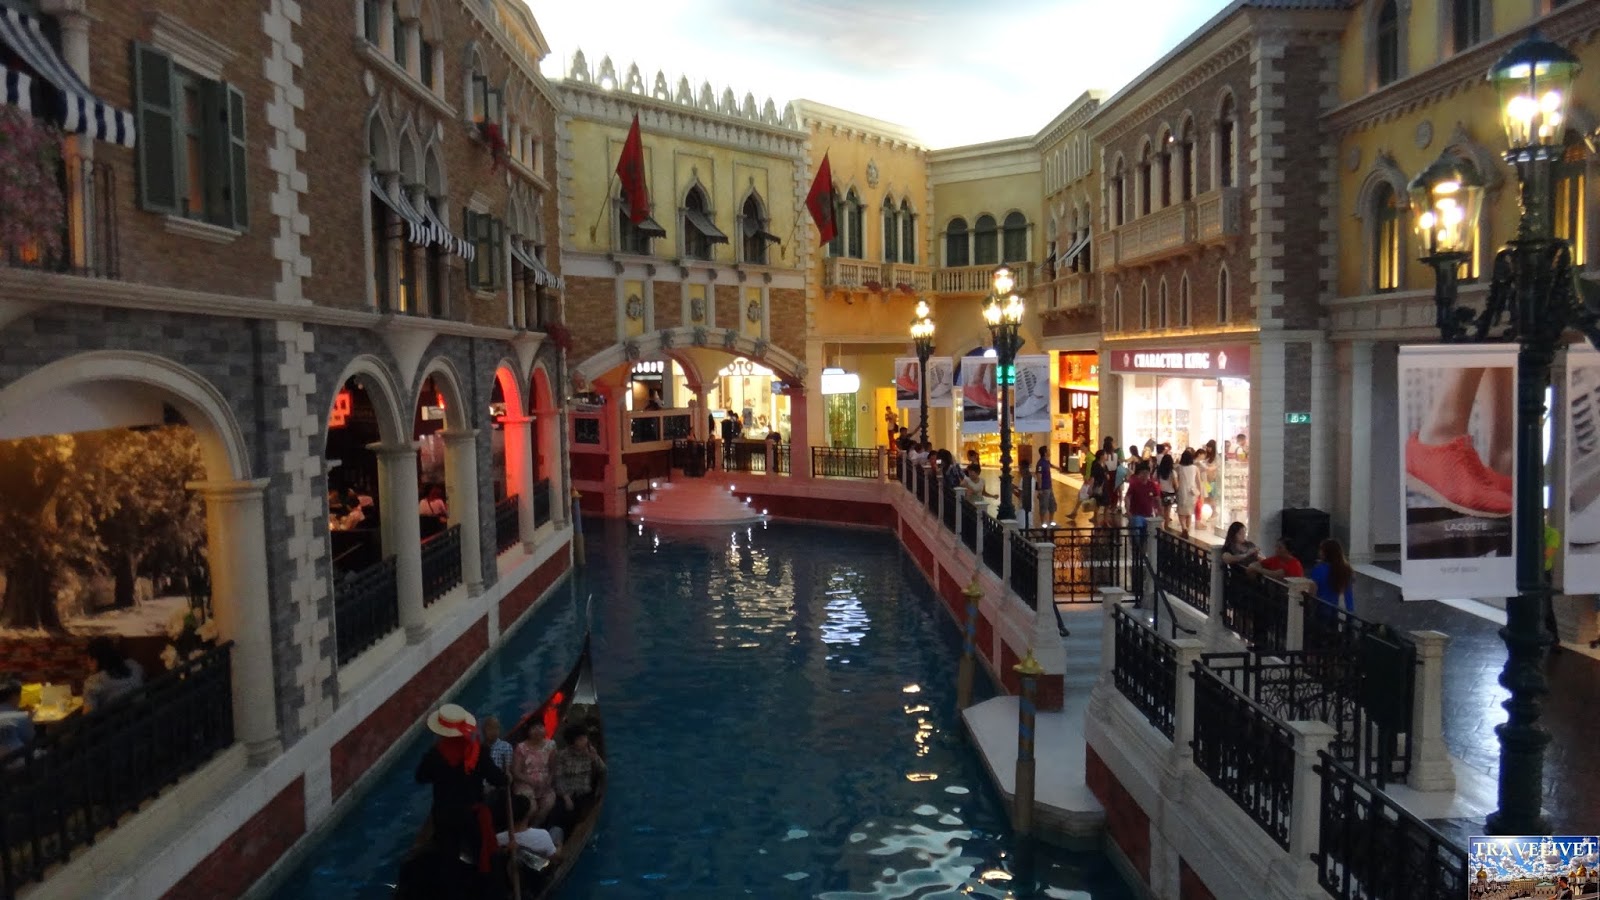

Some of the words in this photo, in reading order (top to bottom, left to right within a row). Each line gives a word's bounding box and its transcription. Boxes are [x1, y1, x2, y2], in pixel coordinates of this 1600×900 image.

[1134, 353, 1183, 368] CHARACTER
[1184, 352, 1210, 369] KING
[1444, 522, 1488, 531] LACOSTE
